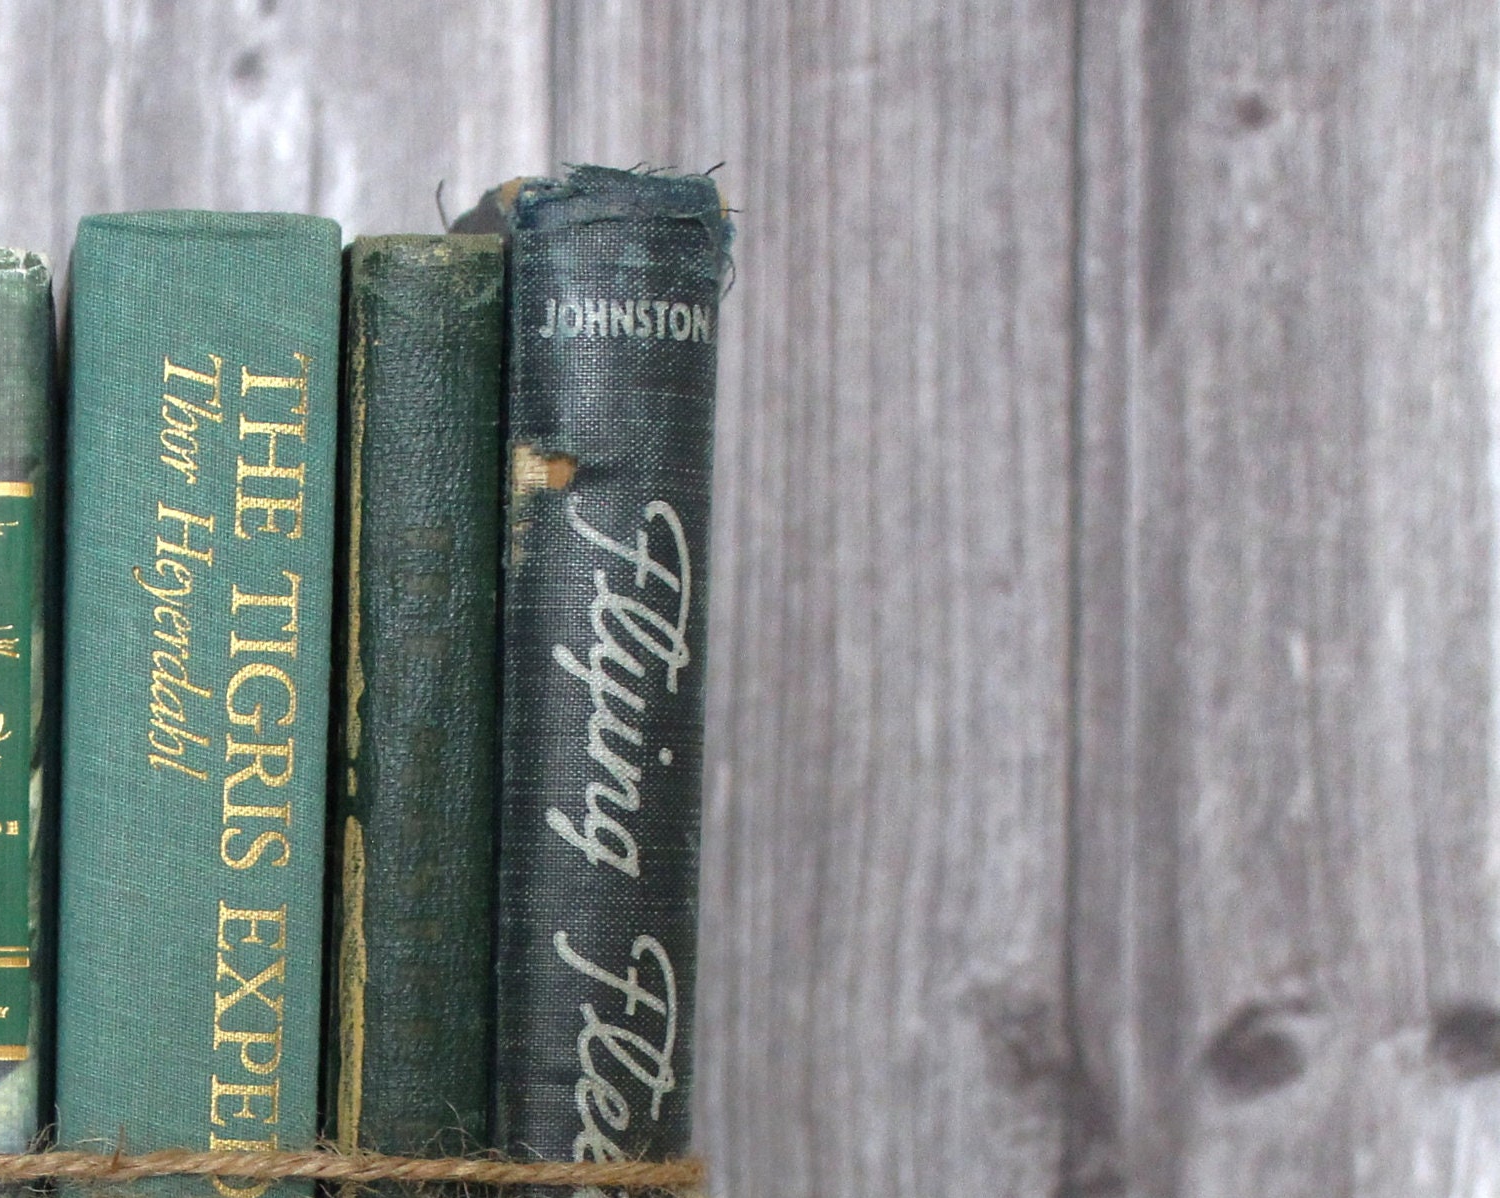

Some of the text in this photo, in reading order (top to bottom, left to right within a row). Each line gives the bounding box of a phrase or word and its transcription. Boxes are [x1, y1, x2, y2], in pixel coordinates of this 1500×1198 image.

[234, 352, 312, 540] THE
[538, 298, 714, 345] JOHNSTON
[132, 353, 224, 781] Thor Heyerdahl
[546, 493, 690, 878] Flying
[219, 570, 302, 871] TIGRIS
